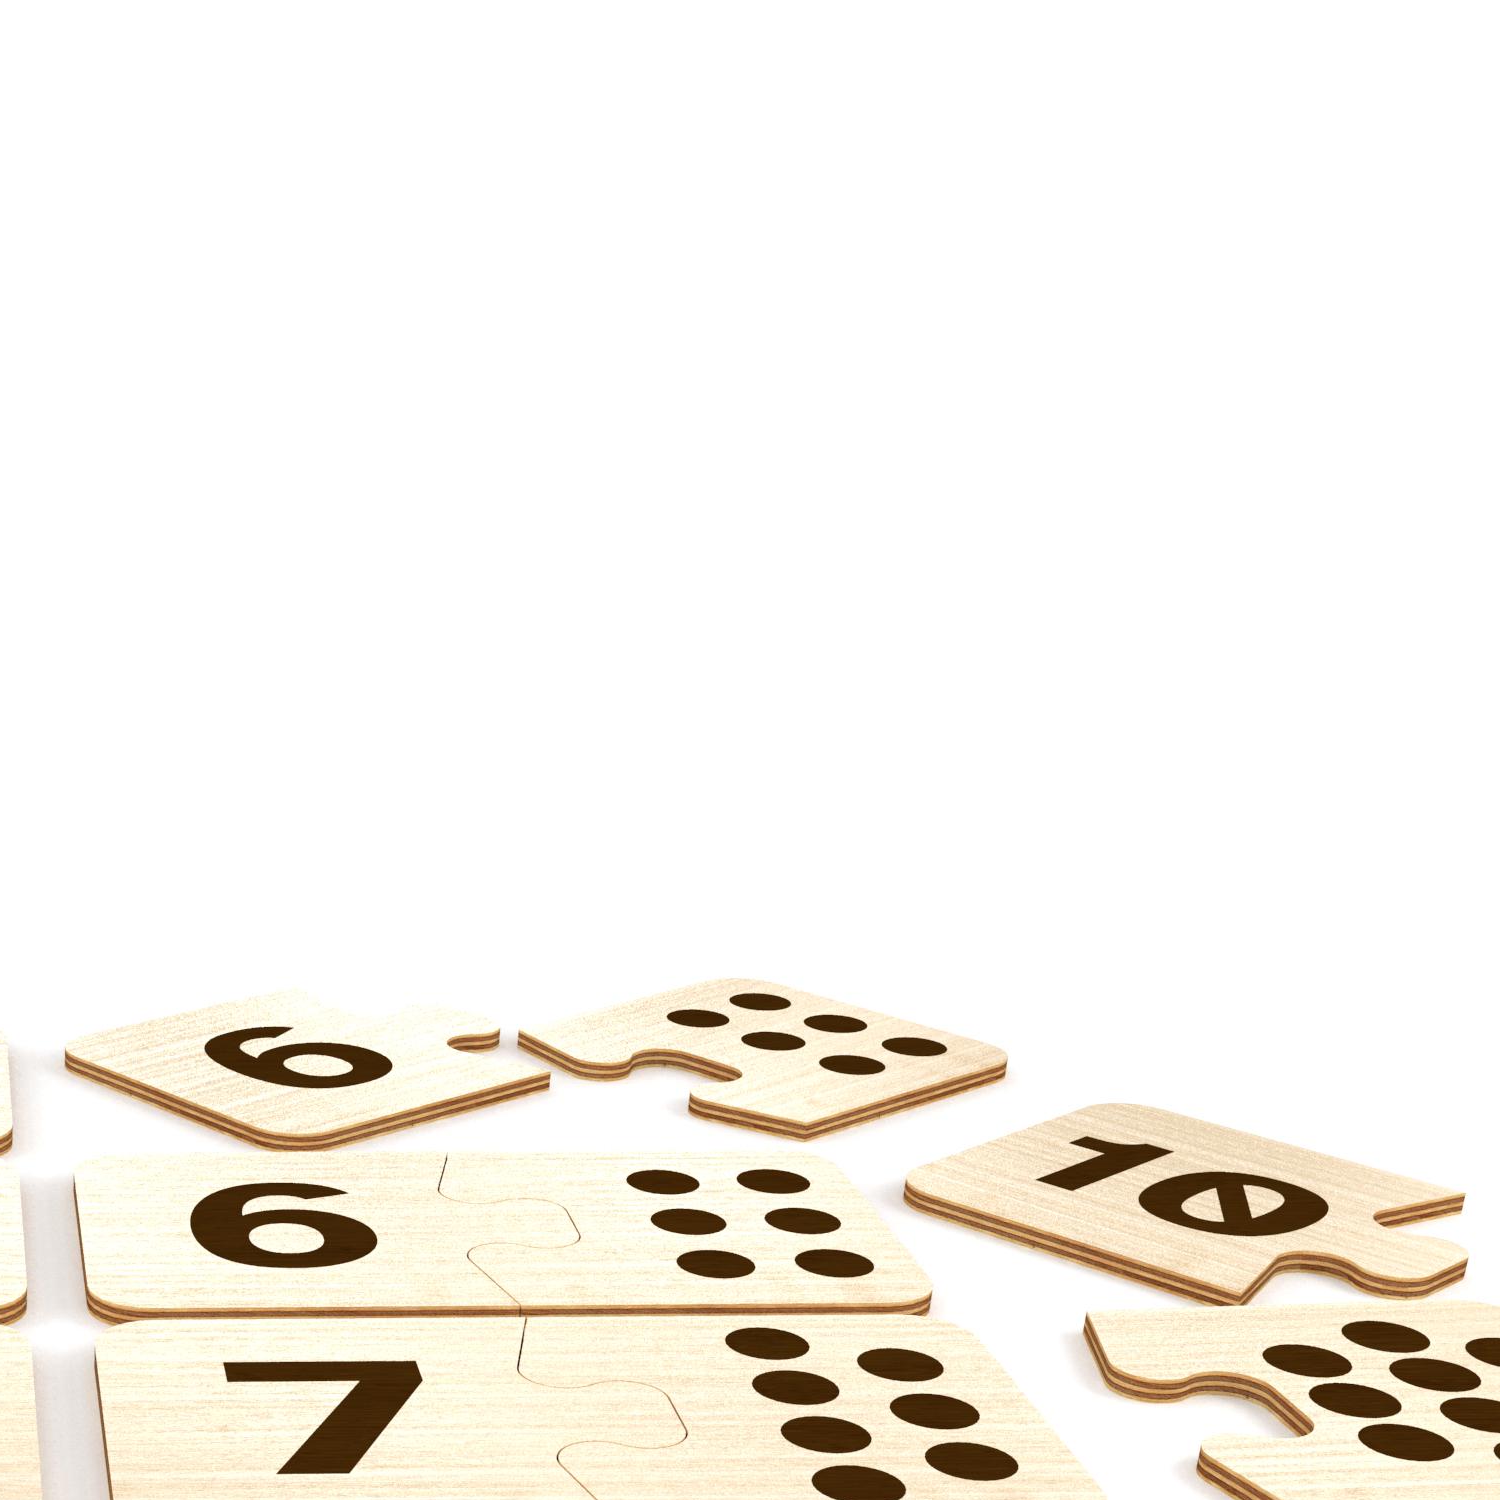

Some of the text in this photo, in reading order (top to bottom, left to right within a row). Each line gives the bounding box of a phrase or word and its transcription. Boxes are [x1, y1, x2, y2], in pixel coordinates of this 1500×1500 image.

[204, 1026, 393, 1089] 6
[190, 1182, 378, 1269] 6
[1036, 1136, 1329, 1237] 10
[223, 1360, 423, 1475] 7
